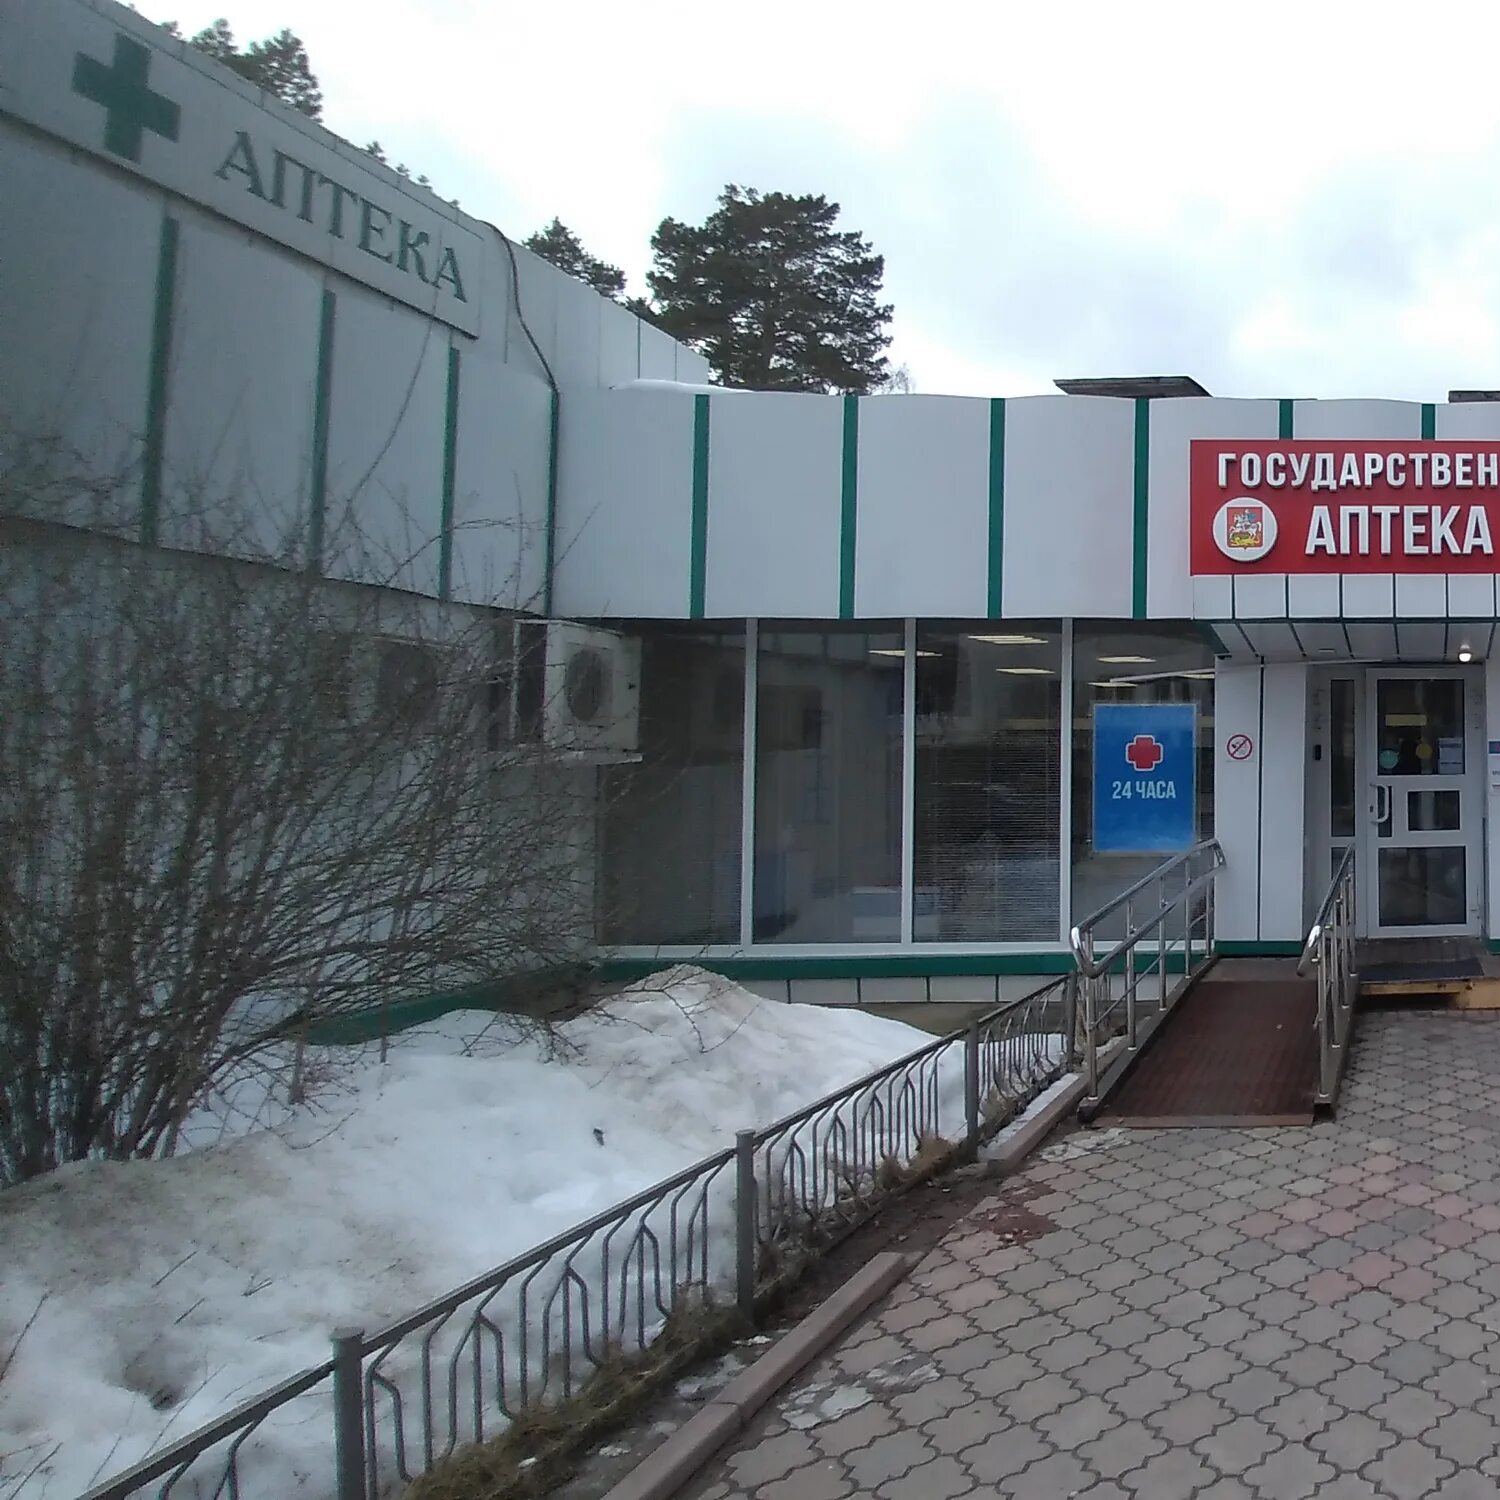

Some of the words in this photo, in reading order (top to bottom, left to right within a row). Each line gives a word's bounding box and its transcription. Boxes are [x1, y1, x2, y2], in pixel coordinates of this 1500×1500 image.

[215, 131, 468, 303] АПТЕКА
[1305, 505, 1494, 556] АПТЕКА
[1112, 780, 1132, 799] 24
[1135, 780, 1176, 799] ЧАСА
